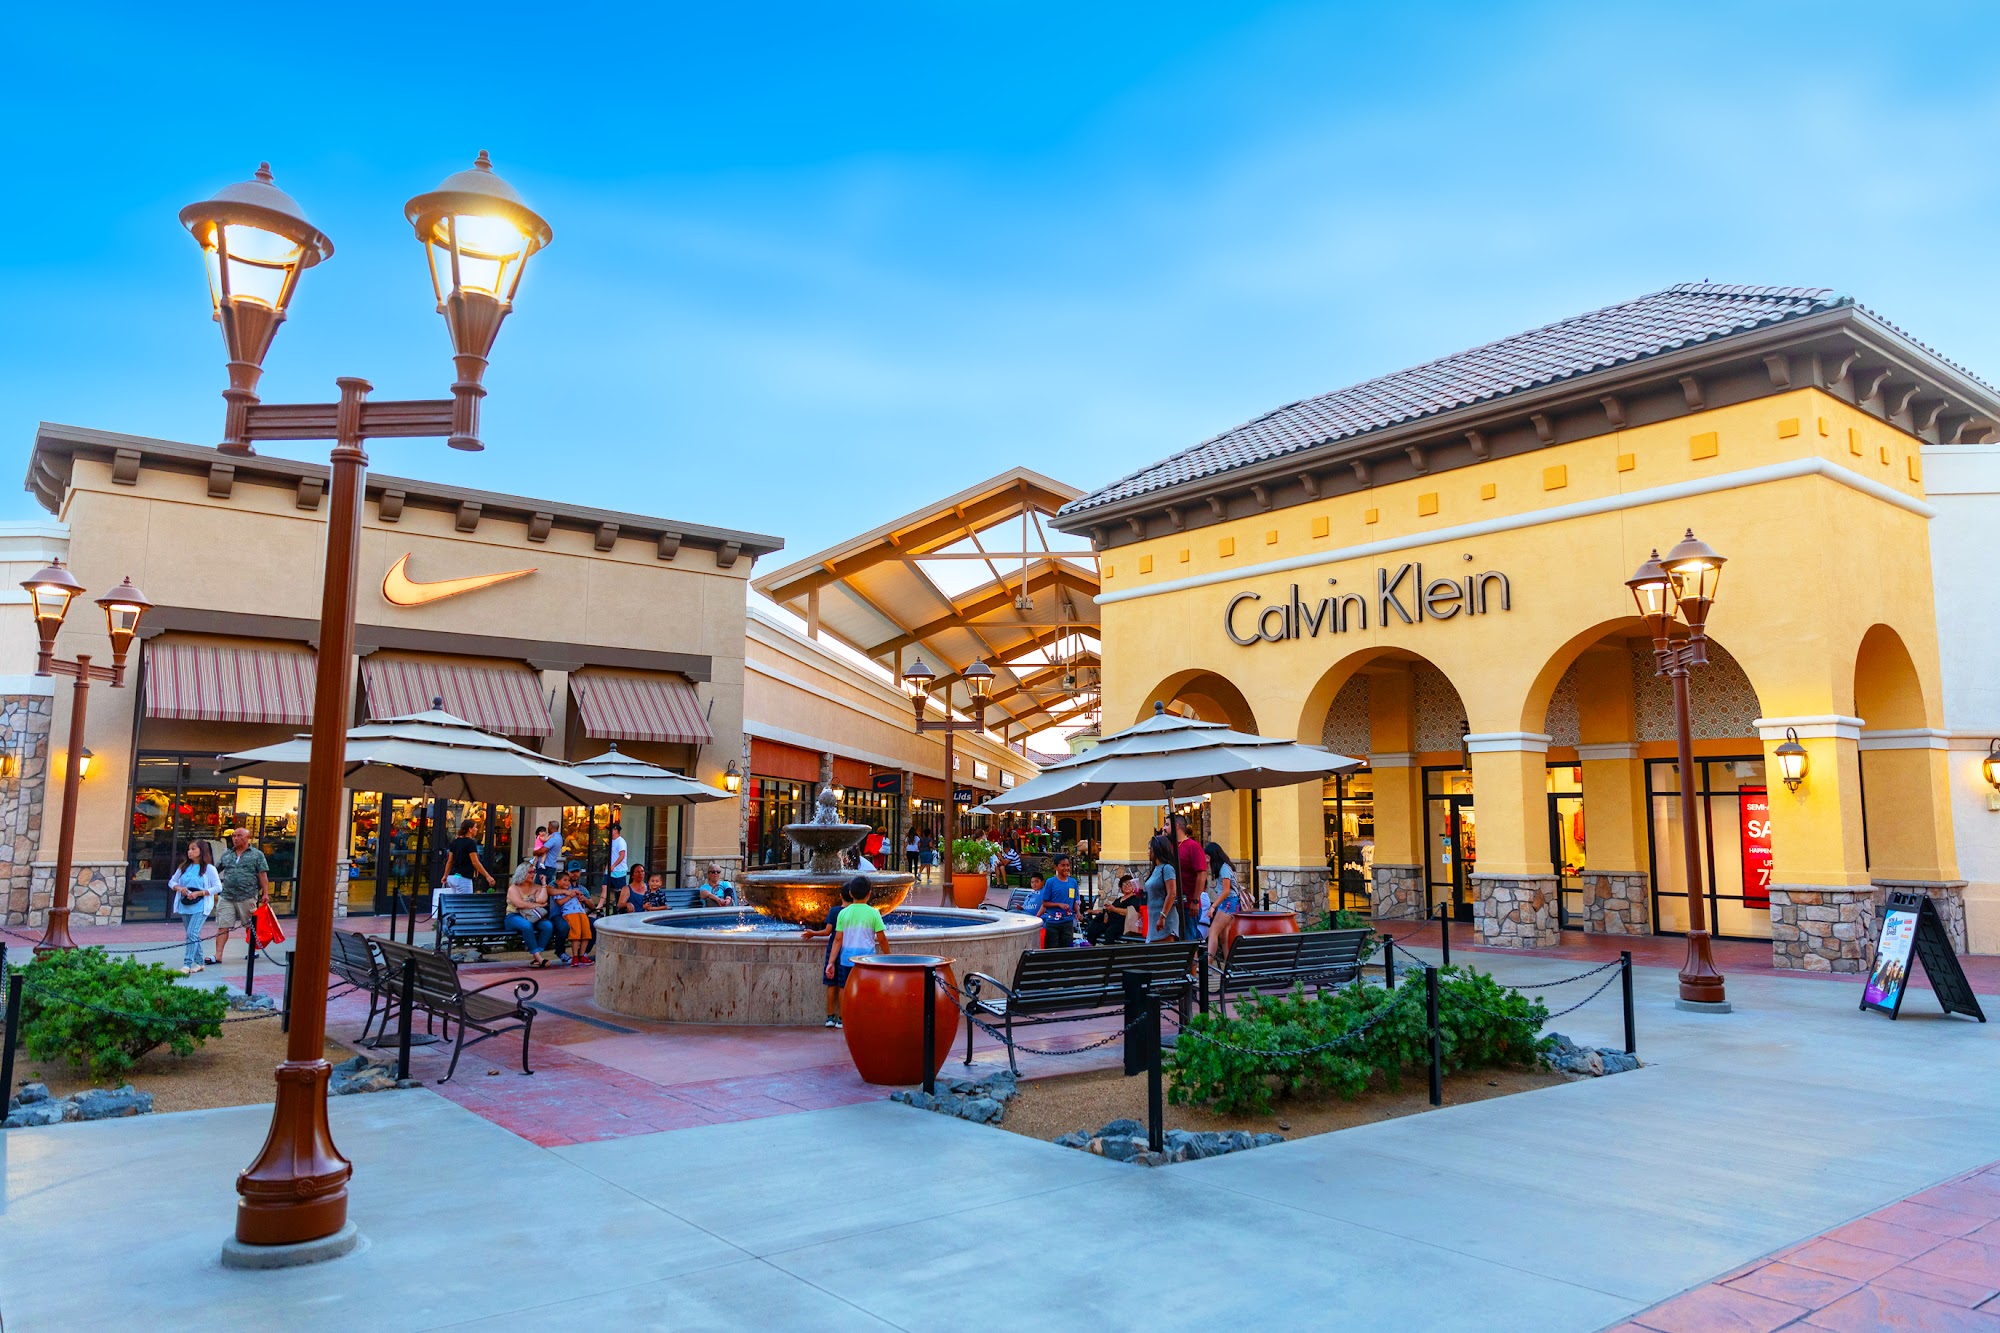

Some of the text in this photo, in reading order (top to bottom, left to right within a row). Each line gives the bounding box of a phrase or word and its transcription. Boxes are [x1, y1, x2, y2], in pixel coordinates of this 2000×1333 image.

[1224, 553, 1511, 646] Calvin Klein
[953, 792, 971, 801] Lids
